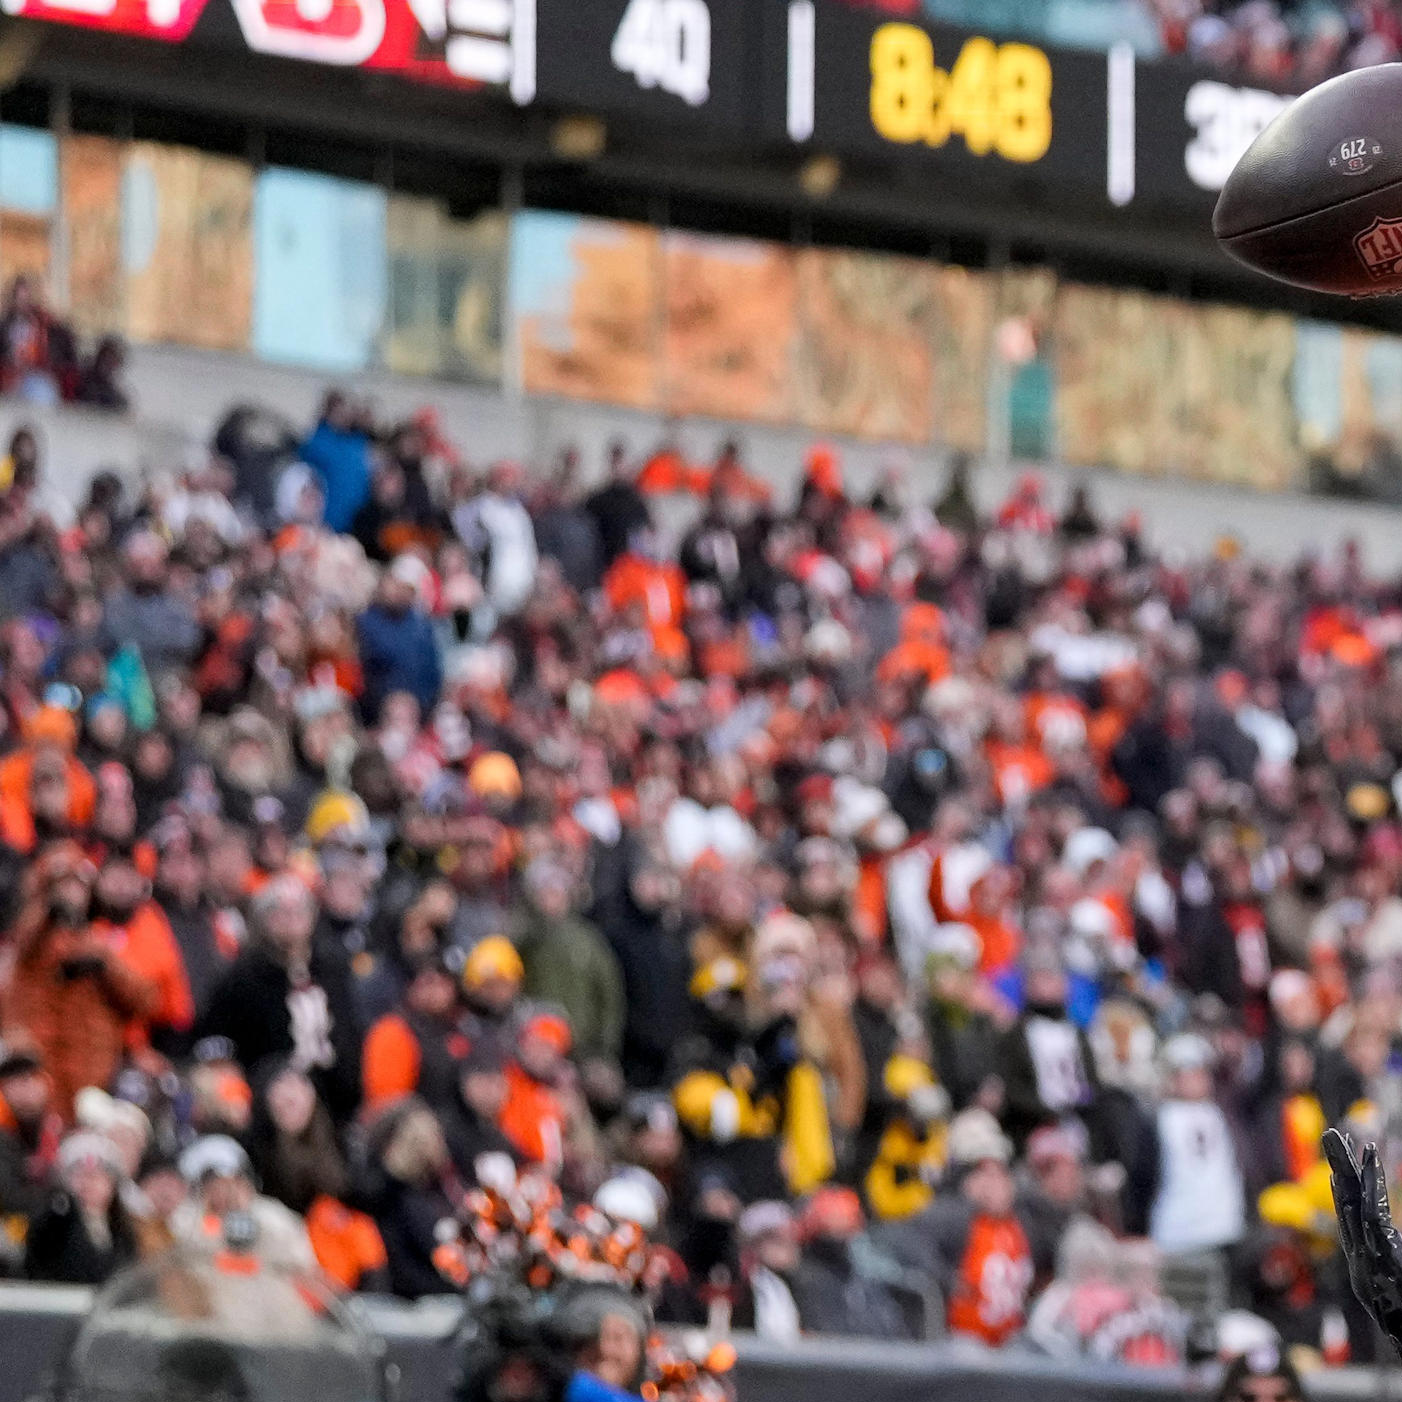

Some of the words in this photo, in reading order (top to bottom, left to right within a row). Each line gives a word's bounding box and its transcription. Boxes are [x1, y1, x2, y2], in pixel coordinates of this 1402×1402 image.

[609, 0, 711, 108] 40
[869, 22, 1053, 163] 8:48
[1340, 138, 1367, 160] 279
